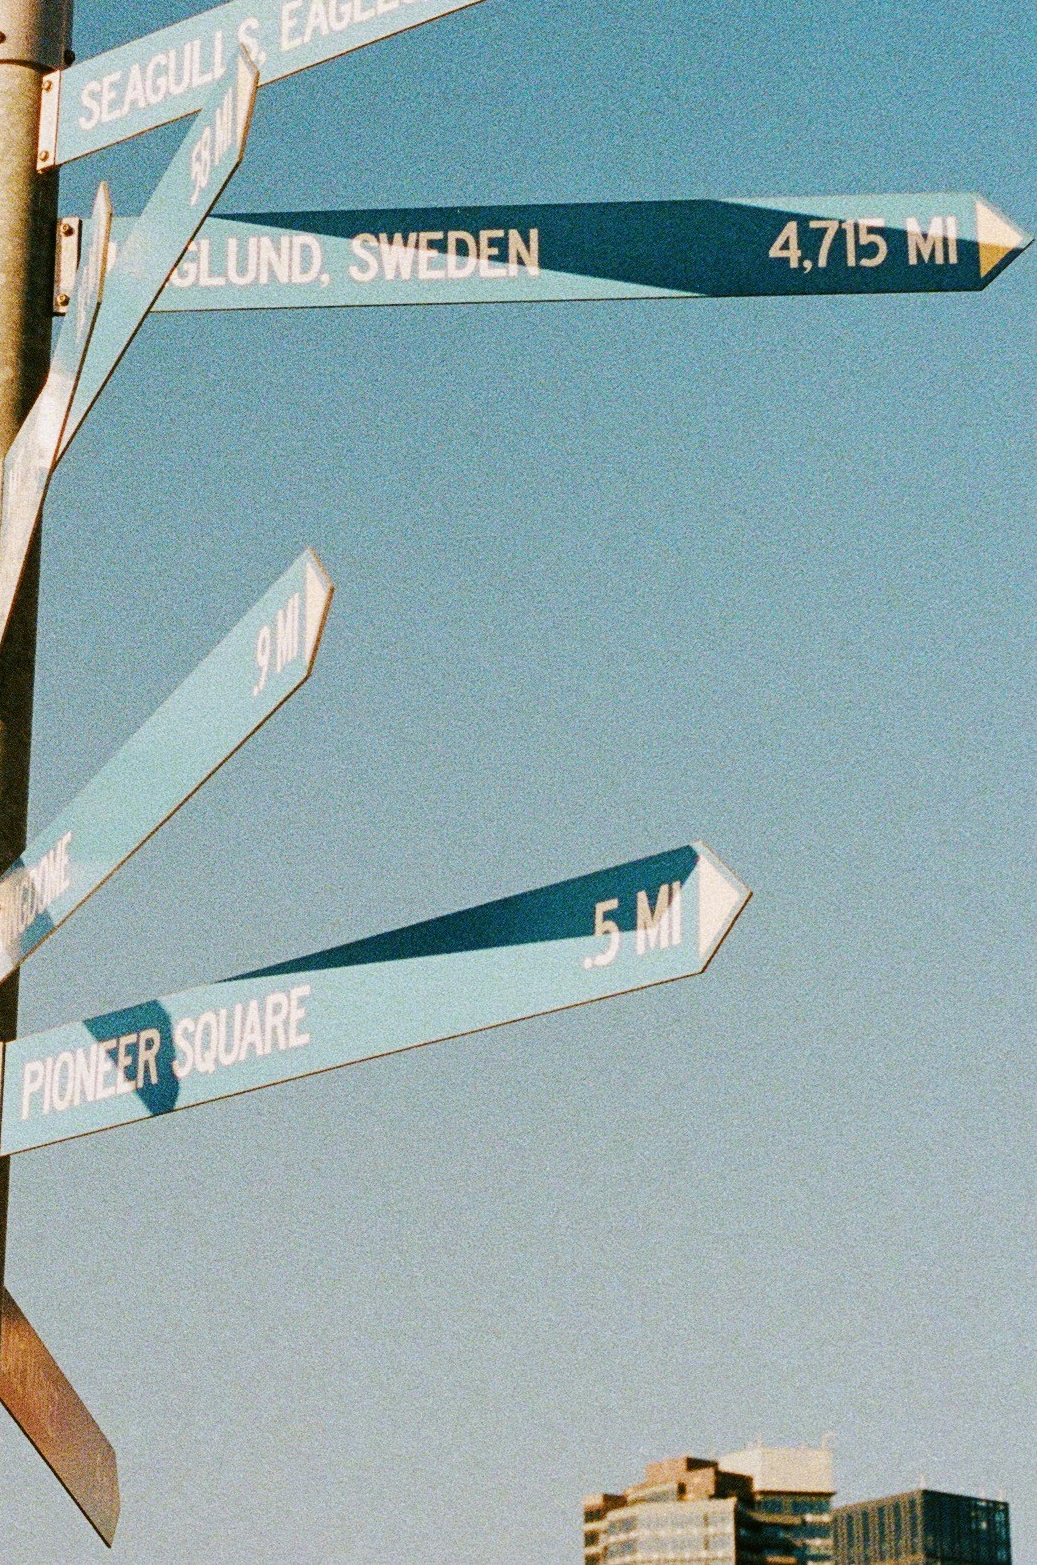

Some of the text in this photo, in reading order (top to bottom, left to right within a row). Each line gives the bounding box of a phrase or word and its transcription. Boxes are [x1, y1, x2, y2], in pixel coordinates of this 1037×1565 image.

[214, 86, 233, 166] MI
[165, 234, 331, 288] GLUND,
[348, 228, 541, 283] SWEDEN
[767, 218, 889, 274] 4,715
[907, 215, 958, 267] MI
[275, 592, 301, 673] MI
[20, 880, 683, 1120] PIONEER SQUARE .5 MI
